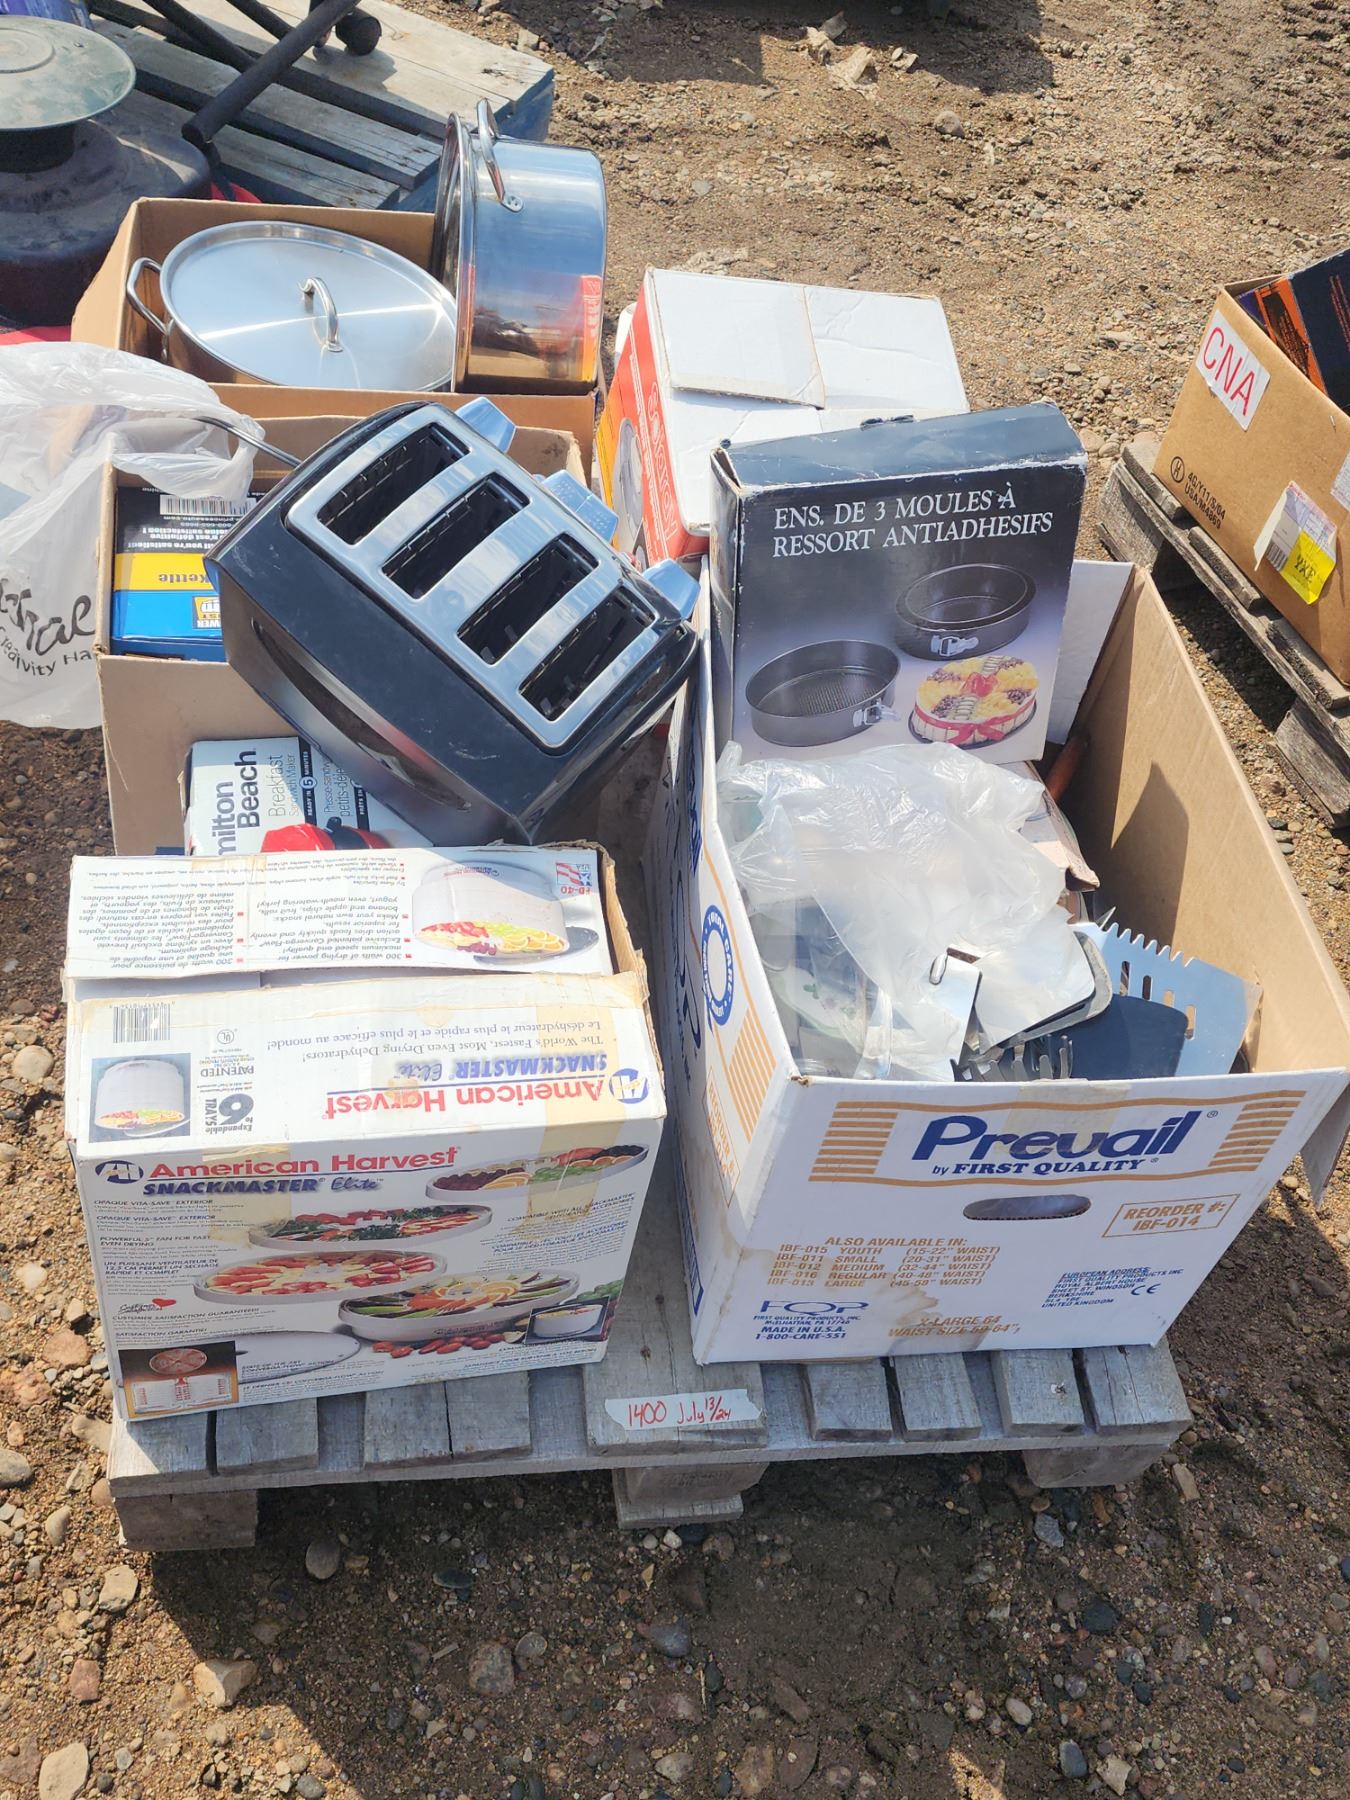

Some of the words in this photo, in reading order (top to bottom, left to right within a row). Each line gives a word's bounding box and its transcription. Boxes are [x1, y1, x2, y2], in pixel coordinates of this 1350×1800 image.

[1203, 326, 1256, 416] CNA
[774, 506, 824, 530] ENS.
[834, 502, 866, 524] DE
[875, 502, 886, 521] 3
[895, 490, 994, 519] MOULES
[999, 481, 1016, 509] À
[772, 529, 875, 558] RESSORT
[883, 512, 1053, 548] ANTIADHESIFS
[159, 574, 211, 583] Kettle
[284, 754, 295, 776] Maker
[234, 751, 260, 828] Beach
[268, 755, 285, 817] Breakfast
[335, 767, 350, 817] petits-déje
[212, 781, 236, 855] milton
[434, 1025, 470, 1038] rapide
[473, 1023, 497, 1035] plus
[499, 1025, 509, 1034] le
[513, 1020, 584, 1034] déshydrateur
[587, 1021, 600, 1030] Le
[333, 1030, 376, 1043] efficace
[379, 1027, 403, 1040] plus
[407, 1029, 417, 1039] le
[420, 1028, 431, 1037] et
[266, 1037, 311, 1050] monde!
[315, 1035, 329, 1044] au
[459, 1041, 486, 1051] Most
[489, 1038, 531, 1049] Fastest,
[535, 1036, 577, 1047] World's
[580, 1035, 603, 1045] The
[300, 1045, 379, 1062] Dehydrators!
[382, 1042, 424, 1056] Drying
[427, 1043, 455, 1053] Even
[199, 1065, 254, 1077] PATENTED
[398, 1062, 443, 1083] Elite
[454, 1053, 607, 1079] SNACKMASTER
[455, 1079, 604, 1109] American
[217, 1092, 255, 1125] 6
[323, 1089, 446, 1119] Harvest
[203, 1098, 218, 1126] TRAYS
[204, 1123, 252, 1134] Expandable
[911, 1110, 1203, 1160] Prevail
[152, 1159, 319, 1178] American
[331, 1147, 459, 1172] Harvest
[932, 1165, 949, 1176] by
[952, 1162, 1030, 1175] FIRST
[1032, 1159, 1146, 1175] QUALITY
[143, 1179, 318, 1195] SNACKMASTER
[331, 1176, 377, 1192] Elite
[1124, 1203, 1205, 1220] REORDER
[1208, 1201, 1227, 1213] #:
[1132, 1216, 1202, 1231] IBF-014
[825, 1237, 865, 1246] ALSO
[868, 1238, 945, 1247] AVAILABLE
[949, 1238, 968, 1246] IN:
[780, 1244, 828, 1254] IBF-015
[839, 1247, 883, 1255] YOUTH
[956, 1246, 1000, 1254] WAIST)
[777, 1253, 824, 1262] IBF-011
[835, 1255, 878, 1263] SMALL
[831, 1263, 885, 1271] MEDIUM
[948, 1263, 991, 1271] WAIST)
[828, 1271, 886, 1279] REGULAR
[943, 1271, 987, 1279] WAIST)
[824, 1279, 866, 1287] LARGE
[939, 1278, 983, 1286] WAIST)
[760, 1300, 869, 1316] FQP
[982, 1315, 1002, 1324] 64
[888, 1327, 934, 1337] WAIST
[936, 1327, 969, 1335] SIZE
[629, 1400, 667, 1427] 1400
